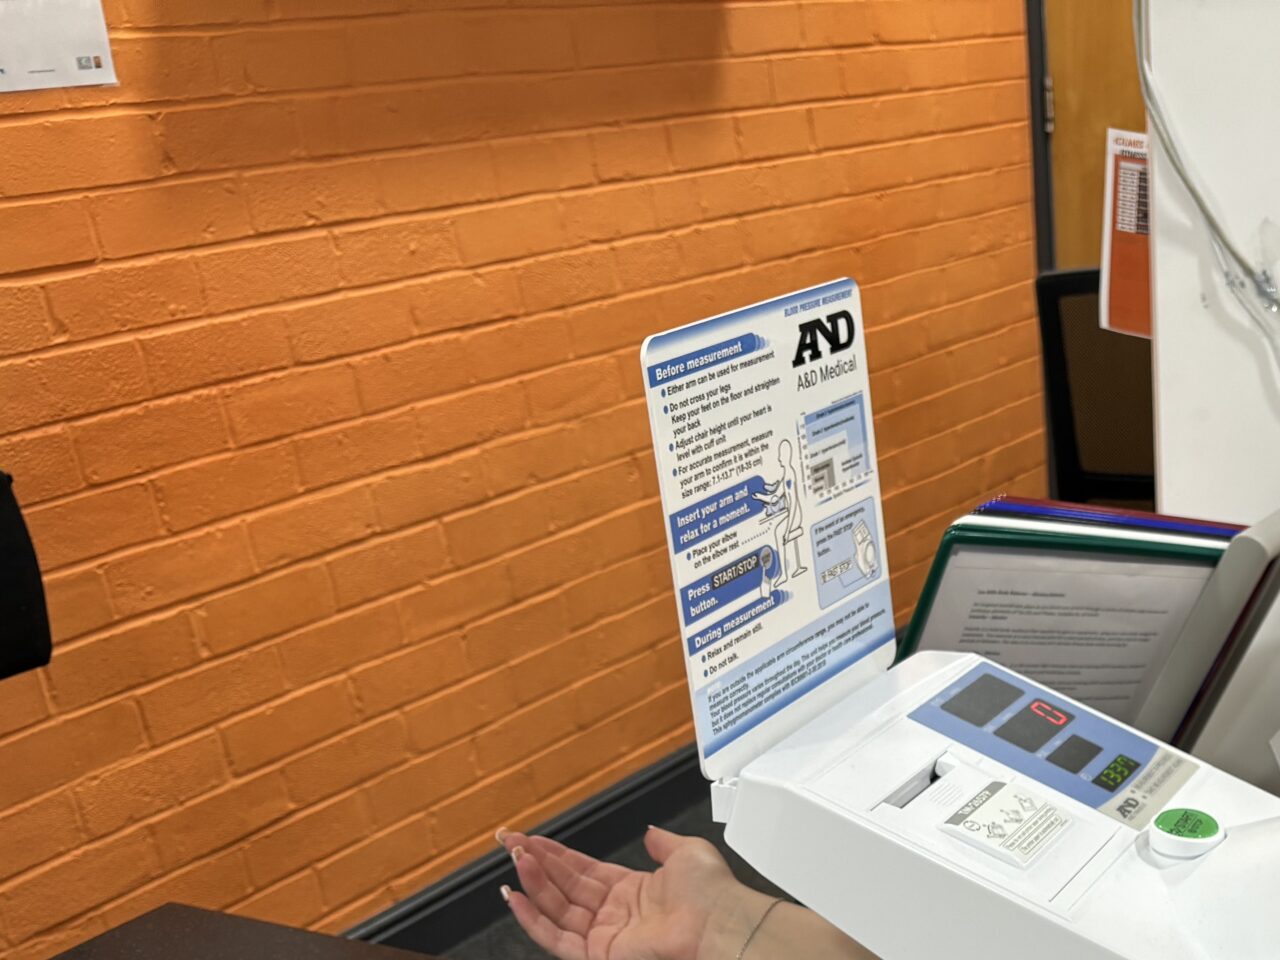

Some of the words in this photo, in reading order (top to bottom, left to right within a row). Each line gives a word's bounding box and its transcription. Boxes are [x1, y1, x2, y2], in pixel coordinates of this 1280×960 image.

[792, 310, 854, 366] AND
[655, 363, 684, 380] Before
[686, 341, 741, 369] measurement
[666, 383, 684, 395] Either
[685, 379, 696, 389] arm
[697, 375, 707, 384] can
[707, 372, 715, 380] be
[716, 365, 730, 377] used
[730, 363, 738, 372] for
[739, 350, 774, 369] measurement
[797, 369, 817, 391] A&D
[819, 354, 856, 381] Medical
[669, 402, 678, 412] Do
[678, 398, 689, 408] not
[689, 393, 705, 404] cross
[705, 387, 718, 400] your
[718, 383, 731, 393] legs
[671, 412, 686, 424] Keep
[686, 407, 699, 420] your
[700, 402, 711, 412] feet
[712, 400, 719, 408] on
[719, 396, 729, 405] the
[729, 391, 742, 401] floor
[743, 385, 753, 396] and
[754, 377, 779, 392] straighten
[672, 425, 686, 438] your
[686, 418, 700, 430] back
[675, 435, 694, 449] Adjust
[694, 429, 708, 441] chair
[708, 422, 726, 435] height
[726, 416, 739, 428] until
[739, 412, 751, 425] your
[752, 406, 766, 417] heart
[676, 448, 690, 461] level
[690, 444, 703, 455] with
[703, 438, 714, 450] cuff
[715, 434, 726, 445] unit
[677, 465, 688, 475] For
[689, 455, 712, 470] accurate
[713, 439, 750, 459] measurement,
[750, 429, 772, 443] measure
[679, 475, 693, 489] your
[693, 470, 704, 481] arm
[704, 467, 711, 475] to
[712, 458, 732, 472] confirm
[733, 455, 737, 463] it
[737, 453, 743, 461] is
[743, 446, 759, 458] within
[760, 443, 768, 451] the
[676, 508, 700, 527] Insert
[700, 501, 717, 518] your
[719, 494, 733, 507] arm
[734, 485, 748, 500] and
[681, 488, 693, 499] size
[679, 528, 699, 543] relax
[699, 522, 711, 534] for
[712, 519, 717, 528] a
[718, 503, 749, 524] moment.
[692, 545, 707, 558] Place
[708, 538, 720, 552] your
[721, 531, 737, 543] elbow
[693, 560, 702, 568] on
[701, 555, 711, 564] the
[711, 547, 727, 559] elbow
[728, 540, 739, 550] rest
[687, 582, 710, 600] Press
[713, 555, 756, 586] START/STOP
[689, 597, 718, 616] button.
[694, 627, 721, 648] During
[723, 596, 774, 631] measurement
[706, 647, 722, 660] Relax
[723, 639, 733, 650] and
[733, 630, 751, 644] remain
[751, 622, 762, 633] still.
[708, 665, 717, 674] Do
[717, 658, 727, 669] not
[727, 652, 738, 663] talk.
